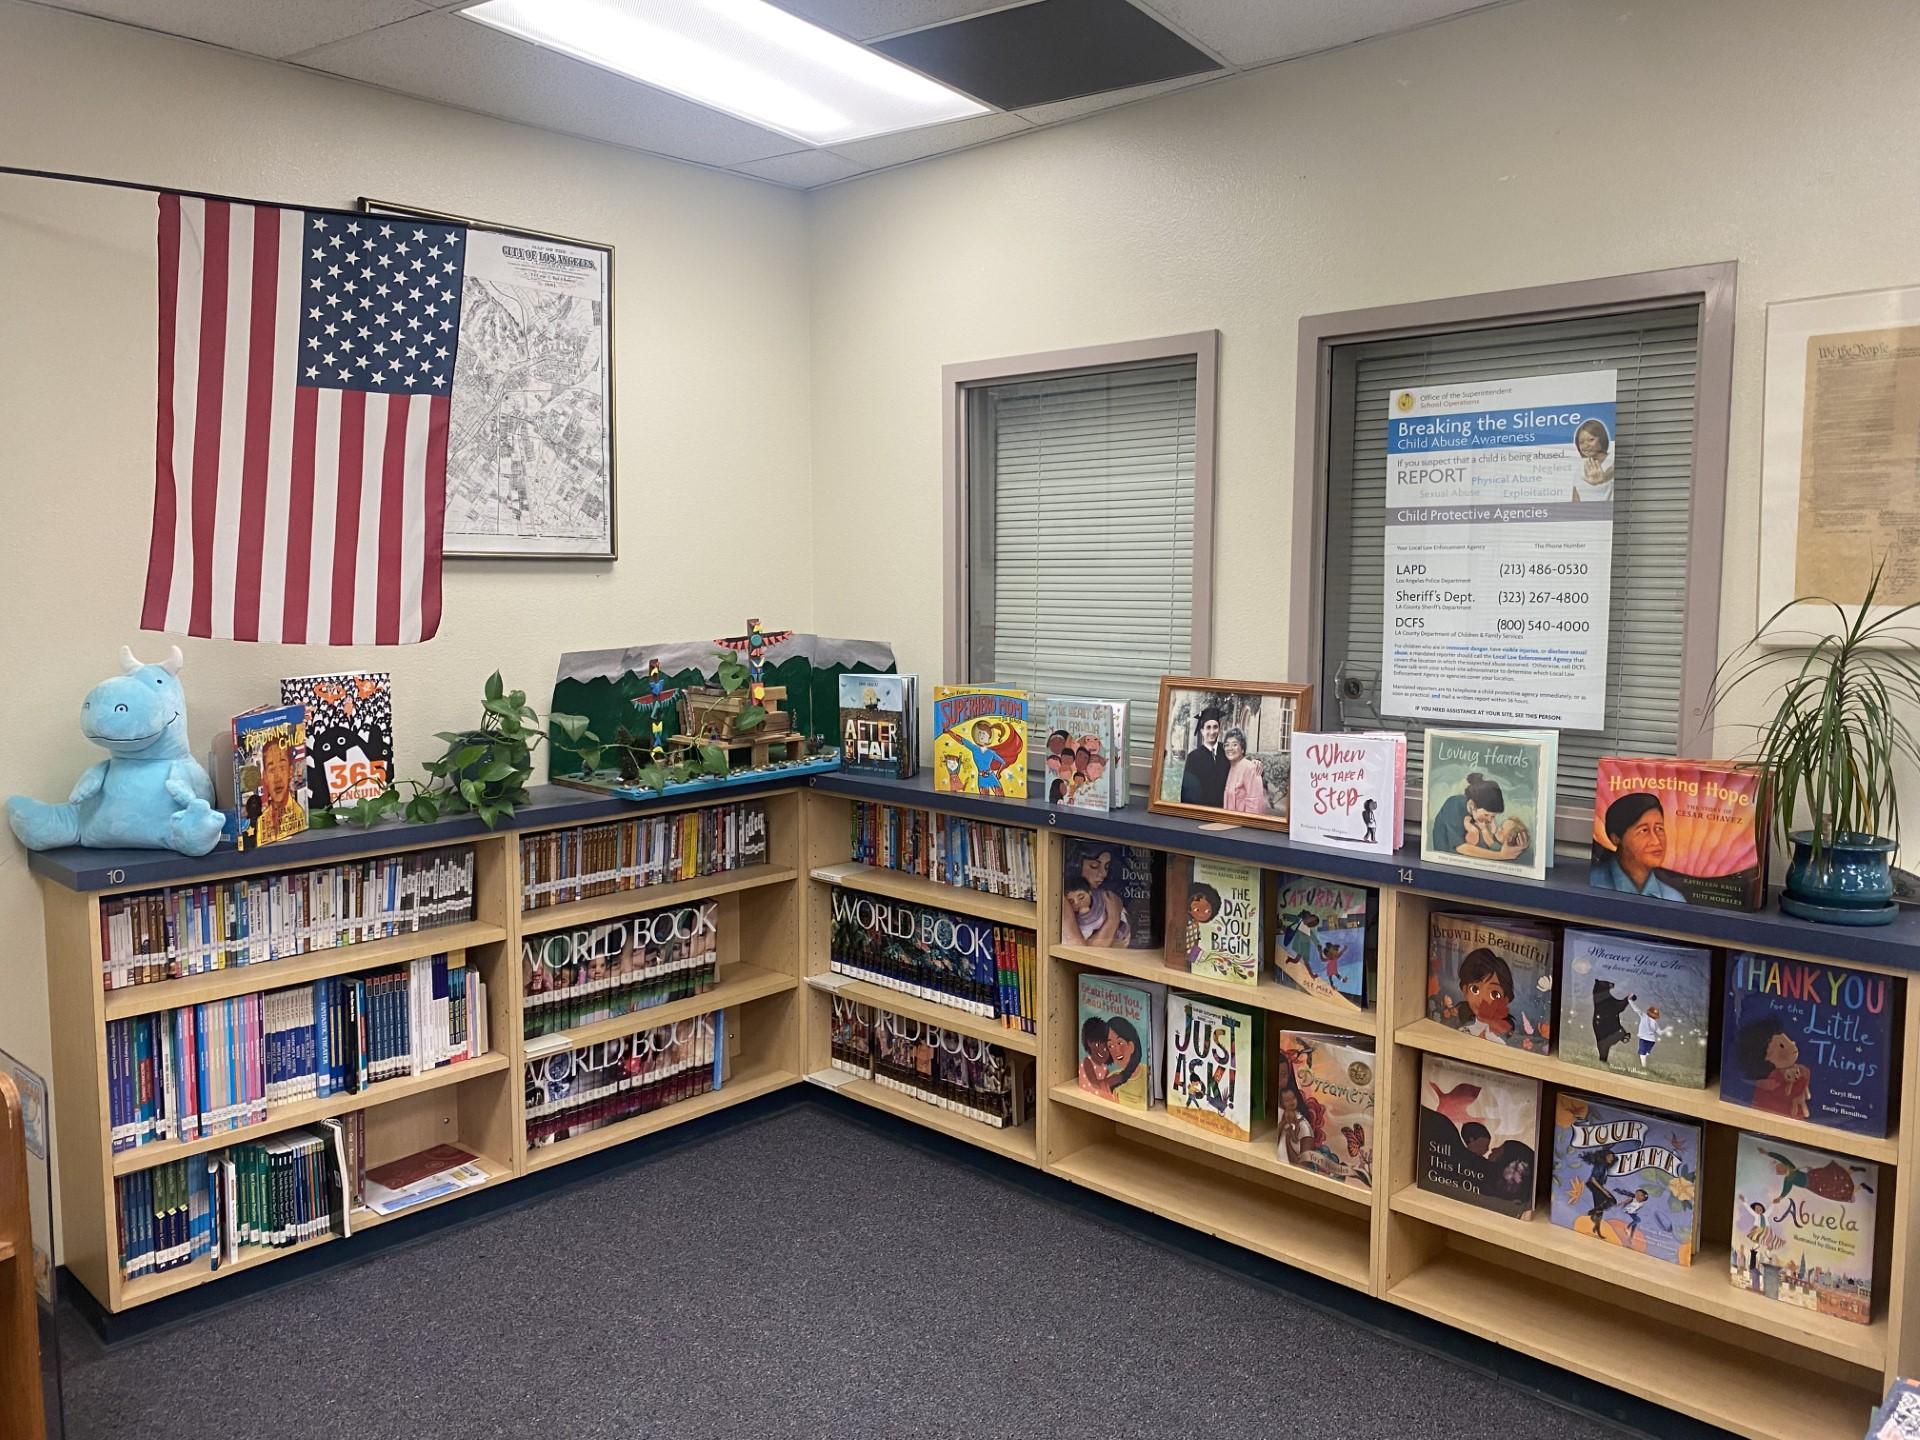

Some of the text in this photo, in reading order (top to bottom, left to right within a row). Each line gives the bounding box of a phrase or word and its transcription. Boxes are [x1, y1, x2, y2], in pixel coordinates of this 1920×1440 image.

[502, 245, 524, 258] CITY
[525, 249, 537, 260] OF
[539, 252, 556, 263] LOS
[1420, 394, 1440, 402] Office
[1450, 391, 1460, 400] the
[1462, 387, 1512, 399] Superintendent
[1420, 400, 1441, 408] School
[1399, 411, 1581, 437] Breaking the Silence
[1398, 432, 1535, 450] Child Abuse Awareness
[1397, 458, 1405, 467] If
[1405, 460, 1420, 469] you
[1422, 457, 1451, 468] suspect
[1452, 456, 1470, 466] that
[1478, 453, 1498, 463] child
[1500, 452, 1506, 461] is
[1508, 450, 1531, 462] being
[1533, 463, 1571, 476] Neglect
[1398, 467, 1467, 485] REPORT
[1472, 473, 1542, 487] Physical Abuse
[1420, 487, 1480, 498] Sexual Abuse
[1503, 486, 1563, 500] Exploitation
[1398, 506, 1549, 522] Child Protective Agencies
[1396, 564, 1427, 575] LAPD
[1500, 563, 1588, 578] (213) 486-0530
[1396, 590, 1475, 605] Sheriff's Dept.
[1499, 590, 1589, 605] (323) 267-4800
[1395, 617, 1424, 628] DCFS
[1497, 618, 1590, 633] (800) 540-4000
[941, 696, 997, 730] SUPERHERO
[844, 719, 898, 743] AFTER
[857, 740, 898, 764] FALL
[1306, 743, 1366, 768] When
[1438, 742, 1529, 768] Loving Hands
[330, 760, 387, 789] 365
[1310, 771, 1328, 788] you
[1356, 768, 1364, 781] A
[1608, 775, 1749, 806] Harvesting Hope
[1314, 787, 1360, 816] Step
[1048, 813, 1057, 825] 3
[1706, 813, 1743, 825] CHAVEZ
[106, 869, 126, 884] 10
[1122, 868, 1153, 881] Down
[1397, 868, 1414, 884] 14
[1124, 886, 1151, 899] Stars
[1231, 888, 1251, 902] THE
[1280, 888, 1354, 912] SATURDAY
[1223, 898, 1250, 920] DAY
[832, 892, 992, 960] WORLD BOOK
[1221, 916, 1251, 937] YOU
[522, 903, 718, 971] WORLD BOOK
[1432, 924, 1550, 967] Brown Is Beautiful
[1588, 946, 1631, 962] Wherever
[1633, 953, 1658, 968] You
[1081, 983, 1121, 1003] Beautiful
[1735, 955, 1885, 1014] THANK YOU
[1082, 993, 1140, 1021] Beautiful Me
[1787, 1002, 1804, 1015] the
[832, 994, 999, 1069] WORLD BOOK
[1804, 1003, 1875, 1046] Little
[1175, 1002, 1241, 1069] JUST
[526, 1012, 715, 1083] WORLD BOOK
[1808, 1037, 1878, 1086] Things
[1173, 1053, 1236, 1109] ASK!
[1297, 1067, 1375, 1108] Dreamers
[1830, 1088, 1846, 1100] Caryl
[1581, 1121, 1645, 1146] YOUR
[1429, 1140, 1451, 1157] Still
[1430, 1154, 1485, 1182] This Love
[1617, 1147, 1675, 1175] MAMA
[1428, 1169, 1481, 1195] Goes On
[1773, 1197, 1860, 1232] Abuela
